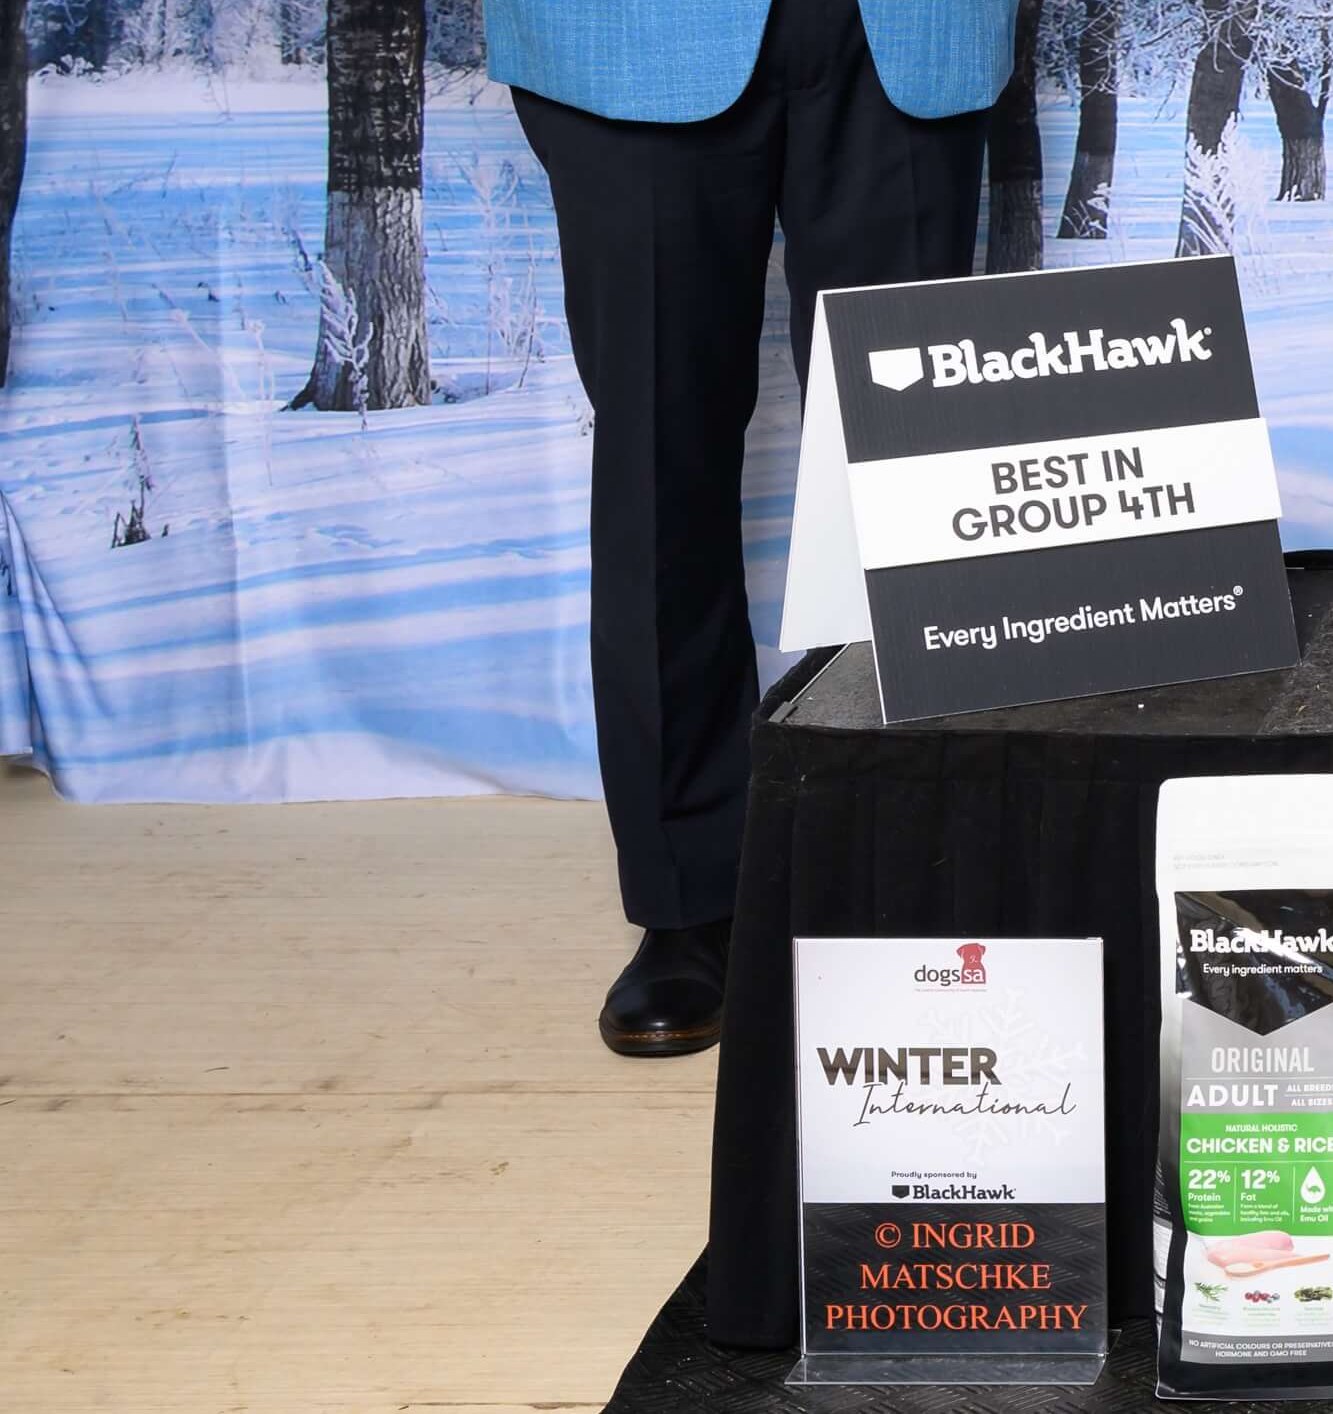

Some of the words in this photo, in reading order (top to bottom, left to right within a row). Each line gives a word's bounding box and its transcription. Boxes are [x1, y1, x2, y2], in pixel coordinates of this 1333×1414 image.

[928, 318, 1213, 388] BlackHawk
[991, 453, 1089, 494] BEST
[1103, 447, 1144, 482] IN
[952, 493, 1107, 541] GROUP
[1119, 483, 1196, 520] 4TH
[924, 624, 998, 650] Every
[1003, 602, 1135, 644] Ingredient
[1203, 962, 1230, 976] Every
[1231, 962, 1282, 976] ingredient
[1284, 964, 1322, 974] matters
[817, 1047, 1002, 1086] WINTER
[1211, 1046, 1315, 1073] ORIGINAL
[1186, 1084, 1278, 1107] ADULT
[1286, 1084, 1302, 1092] ALL
[853, 1082, 1076, 1127] International
[1291, 1098, 1306, 1107] ALL
[1225, 1124, 1260, 1132] NATURAL
[1261, 1124, 1298, 1132] HOLISTIC
[1186, 1137, 1273, 1154] CHICKEN
[1277, 1138, 1290, 1153] &
[891, 1171, 922, 1179] Proudly
[924, 1171, 965, 1179] sponsored
[966, 1171, 977, 1179] by
[1188, 1169, 1231, 1189] 22%
[1240, 1169, 1280, 1189] 12%
[913, 1184, 1016, 1200] BlackHawk
[1188, 1192, 1221, 1202] Protein
[1240, 1192, 1256, 1201] Fat
[1300, 1205, 1321, 1213] Made
[1317, 1214, 1329, 1222] Oil
[1189, 1339, 1199, 1347] NO
[1200, 1341, 1235, 1350] ARTIFICIAL
[1236, 1342, 1270, 1350] COLOURS
[1289, 1349, 1307, 1357] FREE
